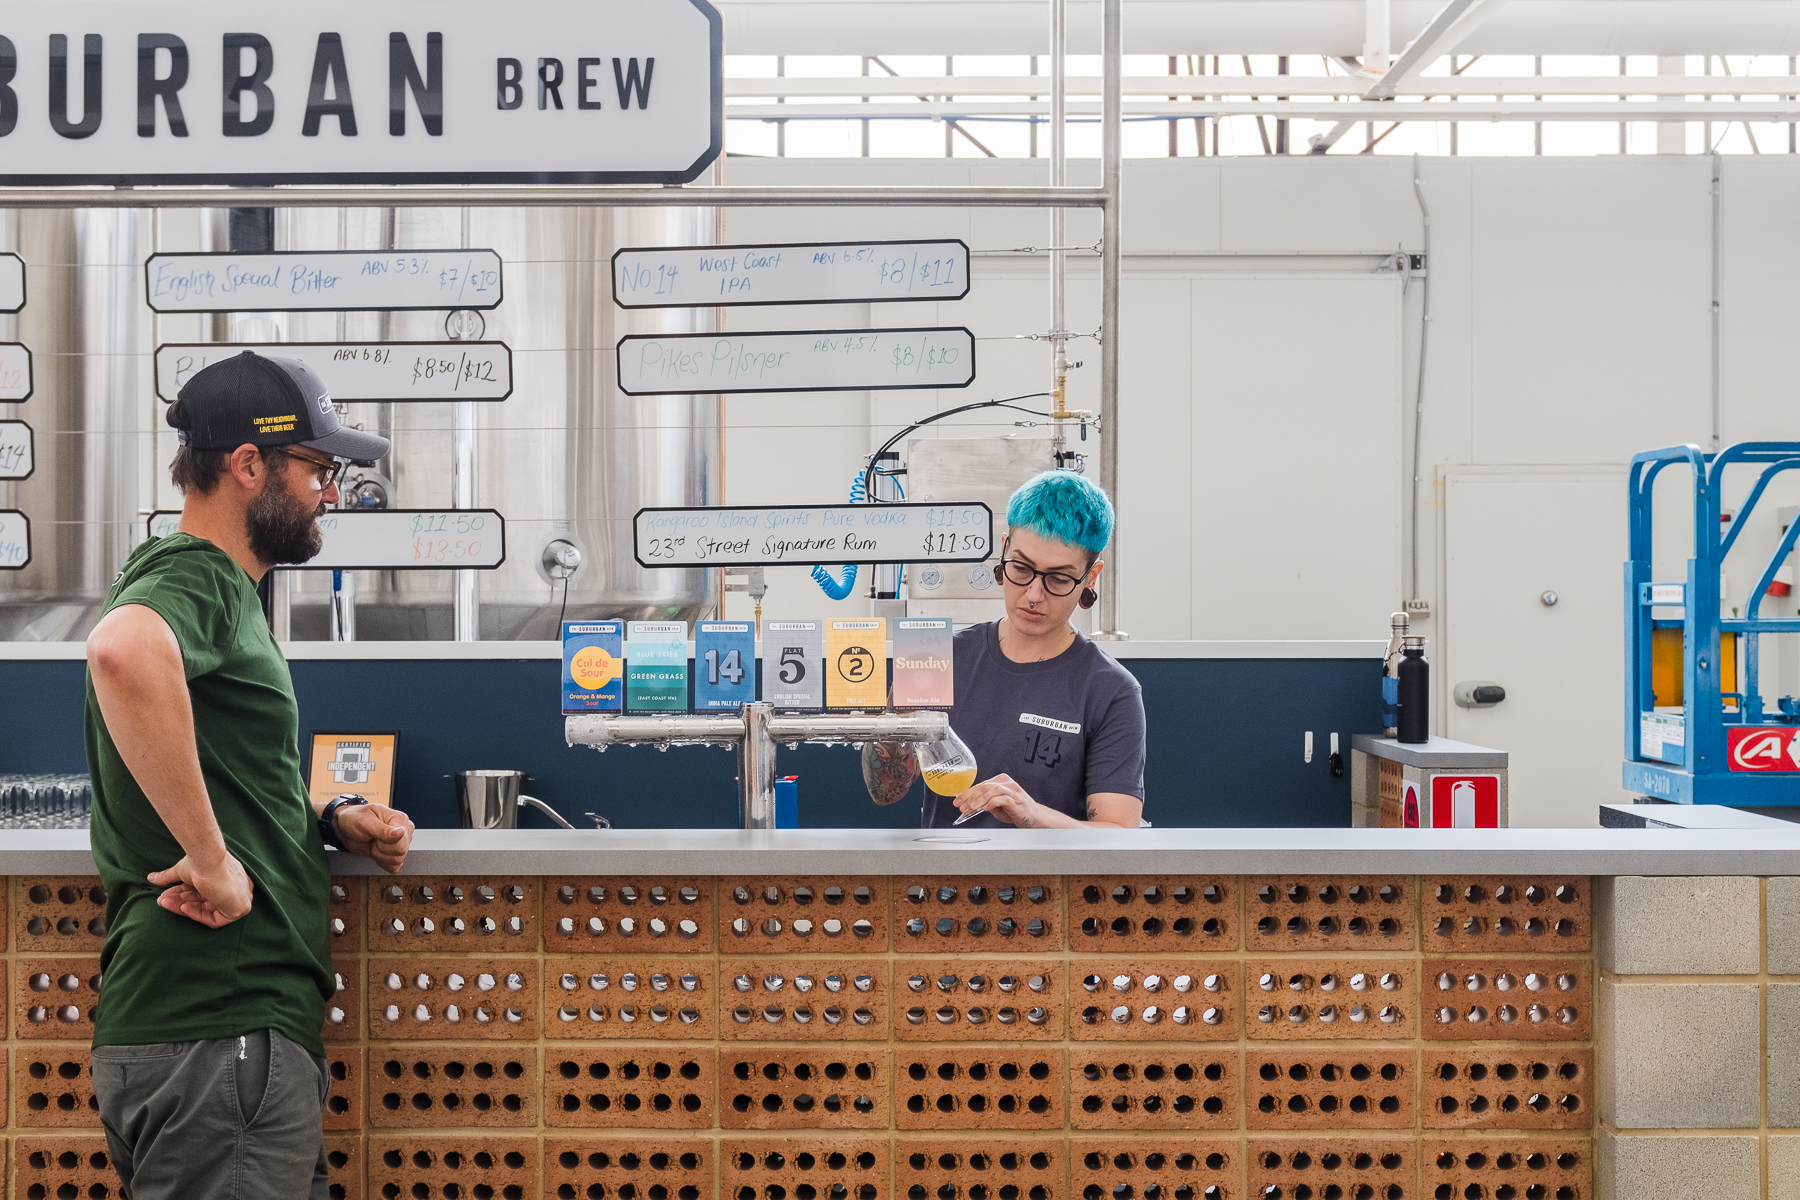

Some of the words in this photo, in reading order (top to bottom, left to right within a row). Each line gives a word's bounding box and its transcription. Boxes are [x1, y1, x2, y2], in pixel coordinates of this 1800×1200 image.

[497, 57, 655, 110] BREW
[699, 256, 738, 272] West
[743, 252, 783, 270] Coast
[720, 276, 751, 295] IPA
[812, 252, 836, 265] ABV
[155, 262, 215, 302] English
[291, 263, 342, 295] Bitter
[361, 260, 389, 275] ABV
[333, 349, 358, 361] ABV
[638, 341, 703, 379] Pikes
[709, 339, 792, 380] Pilsner
[813, 338, 839, 352] ABV
[408, 512, 485, 538] $11.50
[644, 513, 710, 537] Kangaroo
[717, 511, 758, 529] Island
[763, 510, 811, 531] Spirits
[823, 510, 855, 527] Pure
[924, 508, 985, 528] $11.50
[410, 536, 482, 562] $13.50
[695, 535, 751, 559] Street
[761, 533, 836, 560] Signature
[843, 532, 877, 552] Rum
[922, 531, 986, 556] $11.50
[576, 658, 593, 668] Cul
[595, 658, 608, 668] de
[580, 669, 604, 678] Sour
[704, 648, 746, 685] 14
[779, 647, 806, 684] 5
[849, 658, 863, 676] 2
[896, 656, 950, 672] Sunday
[1031, 716, 1069, 730] SUBURBAN
[1024, 728, 1062, 769] 14
[328, 762, 376, 772] INDEPENDENT
